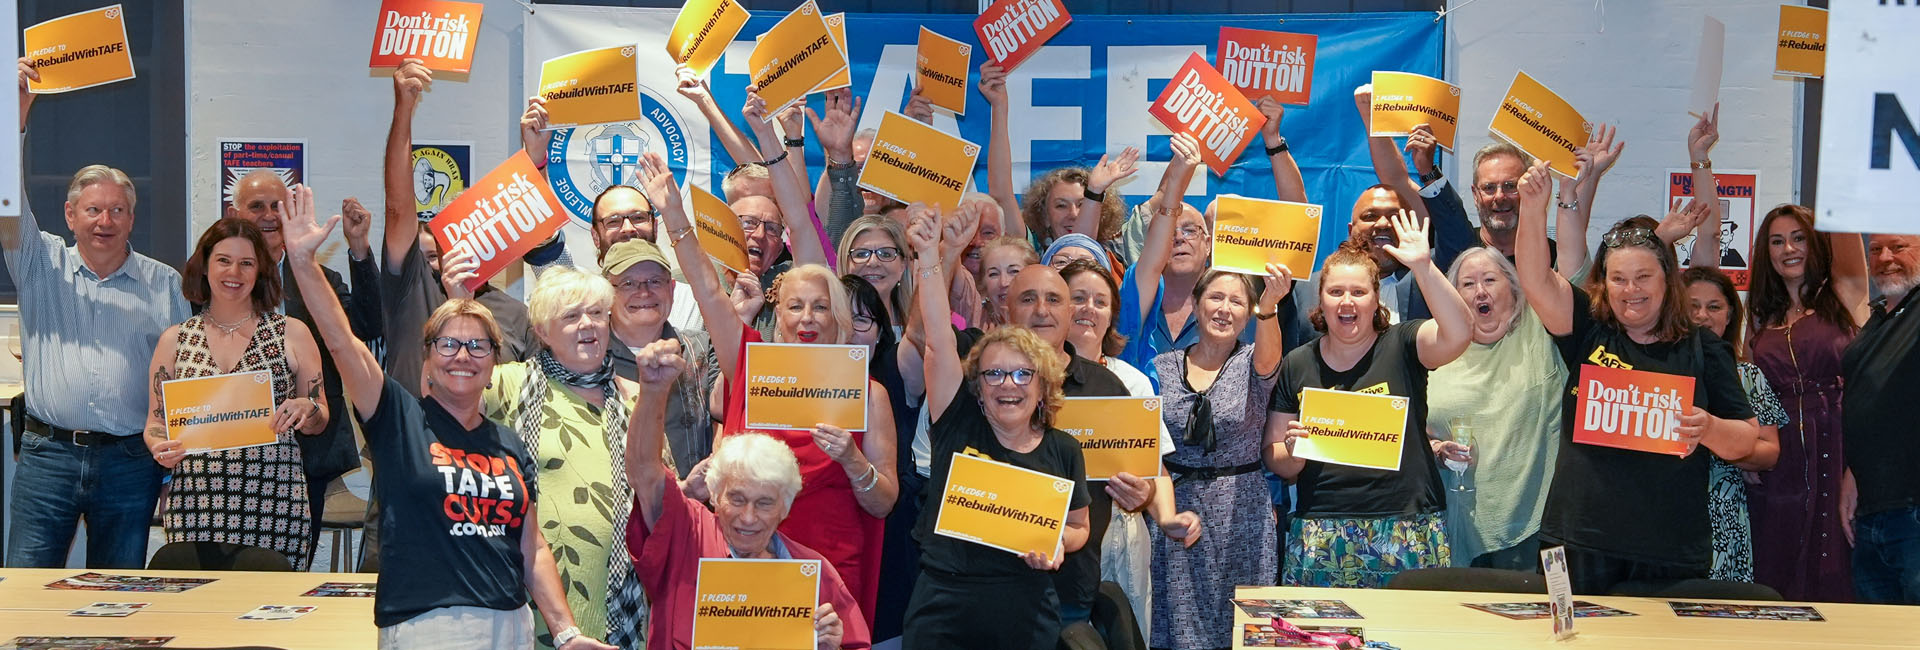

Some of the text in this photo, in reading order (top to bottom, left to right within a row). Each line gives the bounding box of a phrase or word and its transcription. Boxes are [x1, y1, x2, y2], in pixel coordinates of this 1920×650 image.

[384, 10, 470, 33] Don't risk
[682, 0, 730, 63] RebuildWithTAFE
[982, 4, 1019, 41] Don't
[989, 0, 1060, 63] DUTTON
[1787, 30, 1810, 39] PLEDGE
[31, 42, 123, 69] #RebuildWithTAFE
[379, 28, 468, 60] DUTTON
[1225, 40, 1306, 66] Don't risk
[1778, 39, 1826, 52] #Rebuild
[757, 34, 829, 91] RebuildWithTAFE
[1223, 58, 1306, 93] DUTTON
[1181, 67, 1249, 140] Don't risk
[1374, 102, 1456, 125] #RebuildWithTAFE
[724, 41, 1206, 196] AFE
[1163, 82, 1241, 162] DUTTON
[1503, 102, 1576, 153] #RebuildWithTA
[551, 127, 569, 163] STREN
[651, 107, 684, 163] ADVOCACY
[882, 141, 907, 156] PLEDGE
[908, 151, 917, 160] TO
[871, 149, 963, 192] #RebuildWithTAFE
[556, 178, 592, 218] WLEDGE
[1682, 185, 1753, 196] SNGTH
[442, 172, 534, 245] Don't risk
[453, 187, 554, 273] DUTTON
[1223, 224, 1249, 234] PLEDGE
[1250, 227, 1259, 235] TO
[1216, 234, 1314, 253] #RebuildWithTAFE
[749, 386, 862, 400] #RebuildWithTAFE
[751, 375, 797, 384] I PLEDGE TO
[1588, 379, 1682, 411] Don't risk
[169, 407, 270, 427] #RebuildWithTAFE
[175, 406, 201, 415] PLEDGE
[202, 404, 211, 412] TO
[1309, 416, 1335, 425] PLEDGE
[1584, 399, 1682, 442] DUTTON
[1080, 438, 1156, 449] uildWithTAFE
[1085, 428, 1093, 436] TO
[1303, 426, 1399, 443] #RebuildWithTAFE
[437, 465, 514, 500] TAFE
[950, 484, 998, 500] I PLEDGE TO
[946, 494, 1059, 531] #RebuildWithTAFE
[701, 593, 748, 602] I PLEDGE TO
[698, 605, 812, 618] #RebuildWithTAFE
